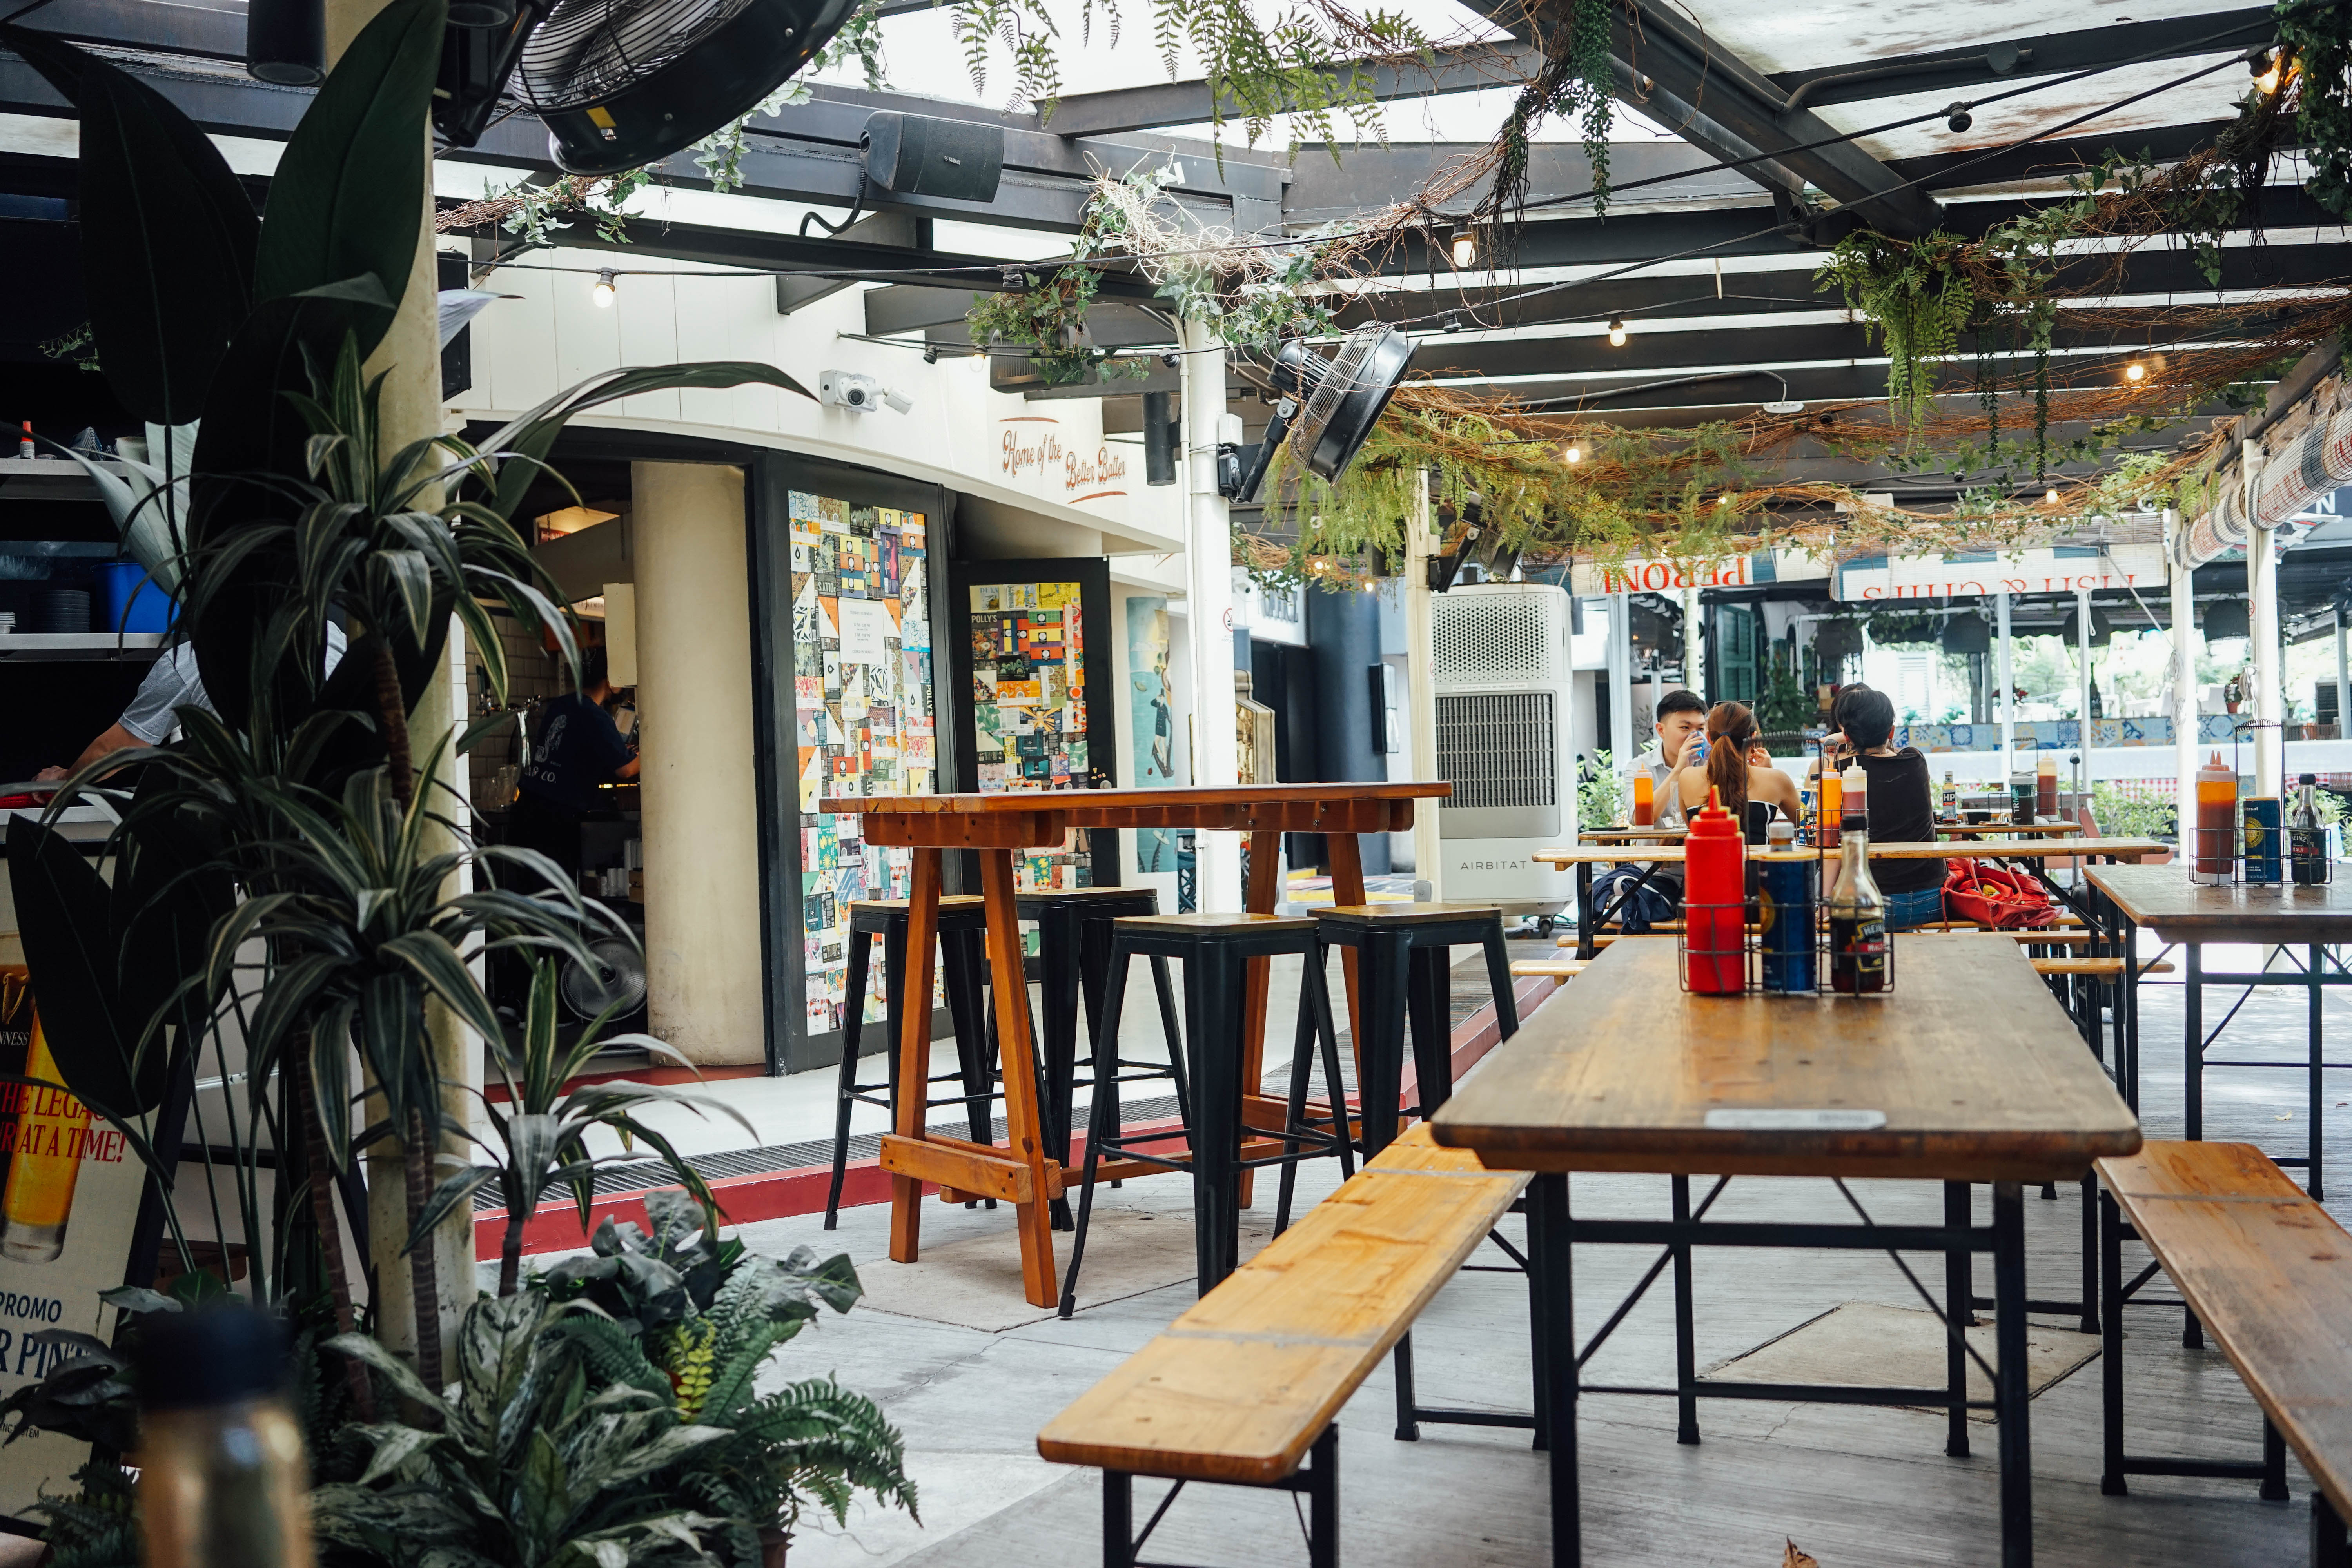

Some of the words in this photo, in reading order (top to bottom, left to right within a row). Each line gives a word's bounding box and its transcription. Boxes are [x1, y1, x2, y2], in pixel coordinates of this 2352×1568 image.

[949, 156, 961, 165] YAMAHA
[1003, 430, 1034, 477] Home
[1038, 434, 1047, 474] of
[1048, 433, 1062, 462] the
[1066, 452, 1094, 490] Better
[1098, 447, 1125, 484] Batter
[971, 614, 998, 623] POLLY'S
[1944, 793, 1955, 802] HP
[1461, 861, 1527, 870] AIRBITAT
[18, 1123, 46, 1154] AT
[45, 1126, 59, 1157] A
[66, 1127, 127, 1163] TIME!
